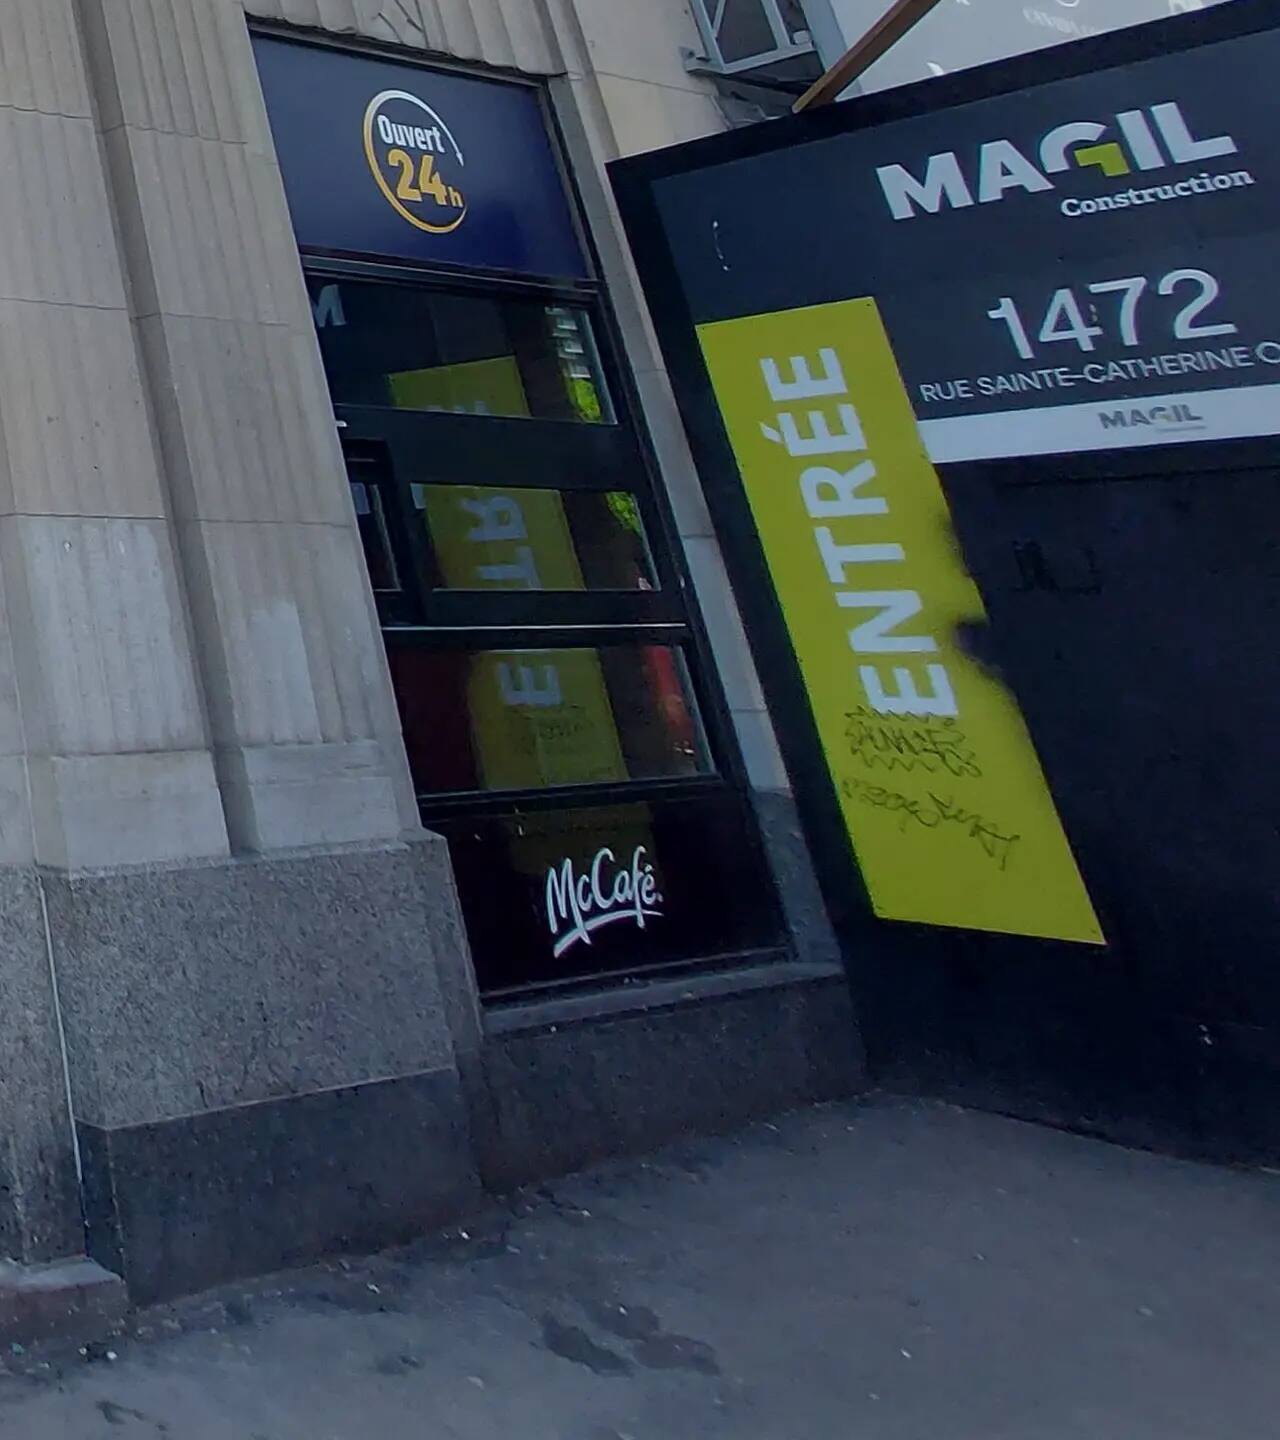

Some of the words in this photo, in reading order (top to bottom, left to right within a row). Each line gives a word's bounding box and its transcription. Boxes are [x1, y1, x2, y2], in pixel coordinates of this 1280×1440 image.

[377, 114, 446, 153] Ouvert
[876, 101, 1238, 220] MAGIL
[1060, 167, 1255, 217] Construction
[987, 268, 1239, 360] 1472
[919, 378, 974, 403] RUE
[977, 346, 1255, 396] SAINTE-CATHERINE
[759, 347, 959, 716] ENTRÉE
[546, 845, 664, 958] McCafé
